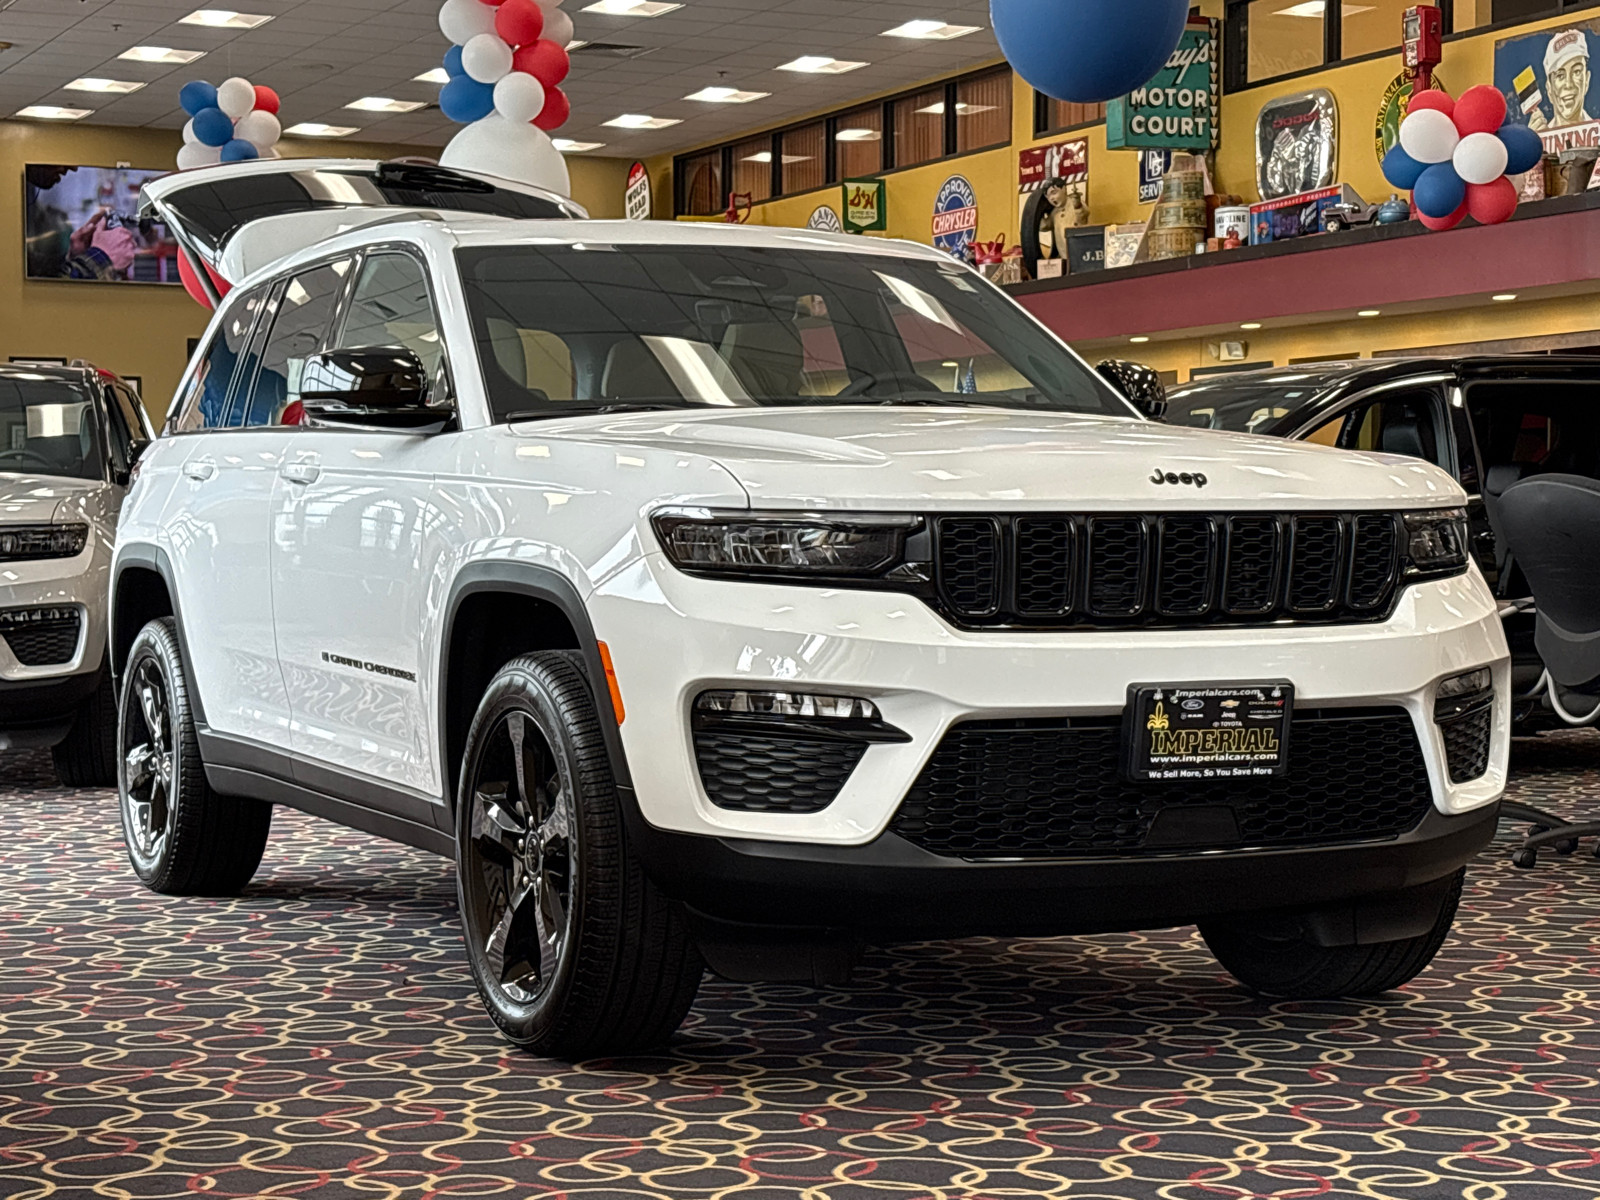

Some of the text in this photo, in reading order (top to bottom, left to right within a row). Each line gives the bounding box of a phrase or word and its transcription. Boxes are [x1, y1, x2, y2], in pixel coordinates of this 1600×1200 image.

[1165, 38, 1209, 84] ay's
[1130, 87, 1207, 107] MOTOR
[1376, 80, 1400, 129] NATIONAL
[1131, 115, 1207, 135] COURT
[1541, 126, 1599, 154] UNING
[937, 180, 973, 212] APPROVED
[1140, 180, 1163, 199] SERVI
[809, 208, 839, 232] TLANTI
[933, 208, 976, 234] CHRYSLER
[1148, 468, 1208, 489] Jeep
[1174, 689, 1261, 699] Imperialcars.com
[1221, 711, 1237, 719] Jeep
[1150, 728, 1279, 754] IMPERIAL
[1150, 753, 1278, 764] www.imperialcars.com
[1149, 770, 1162, 779] We
[1163, 770, 1178, 778] Sell
[1203, 769, 1214, 777] So
[1232, 767, 1251, 776] Save
[1253, 767, 1273, 775] More
